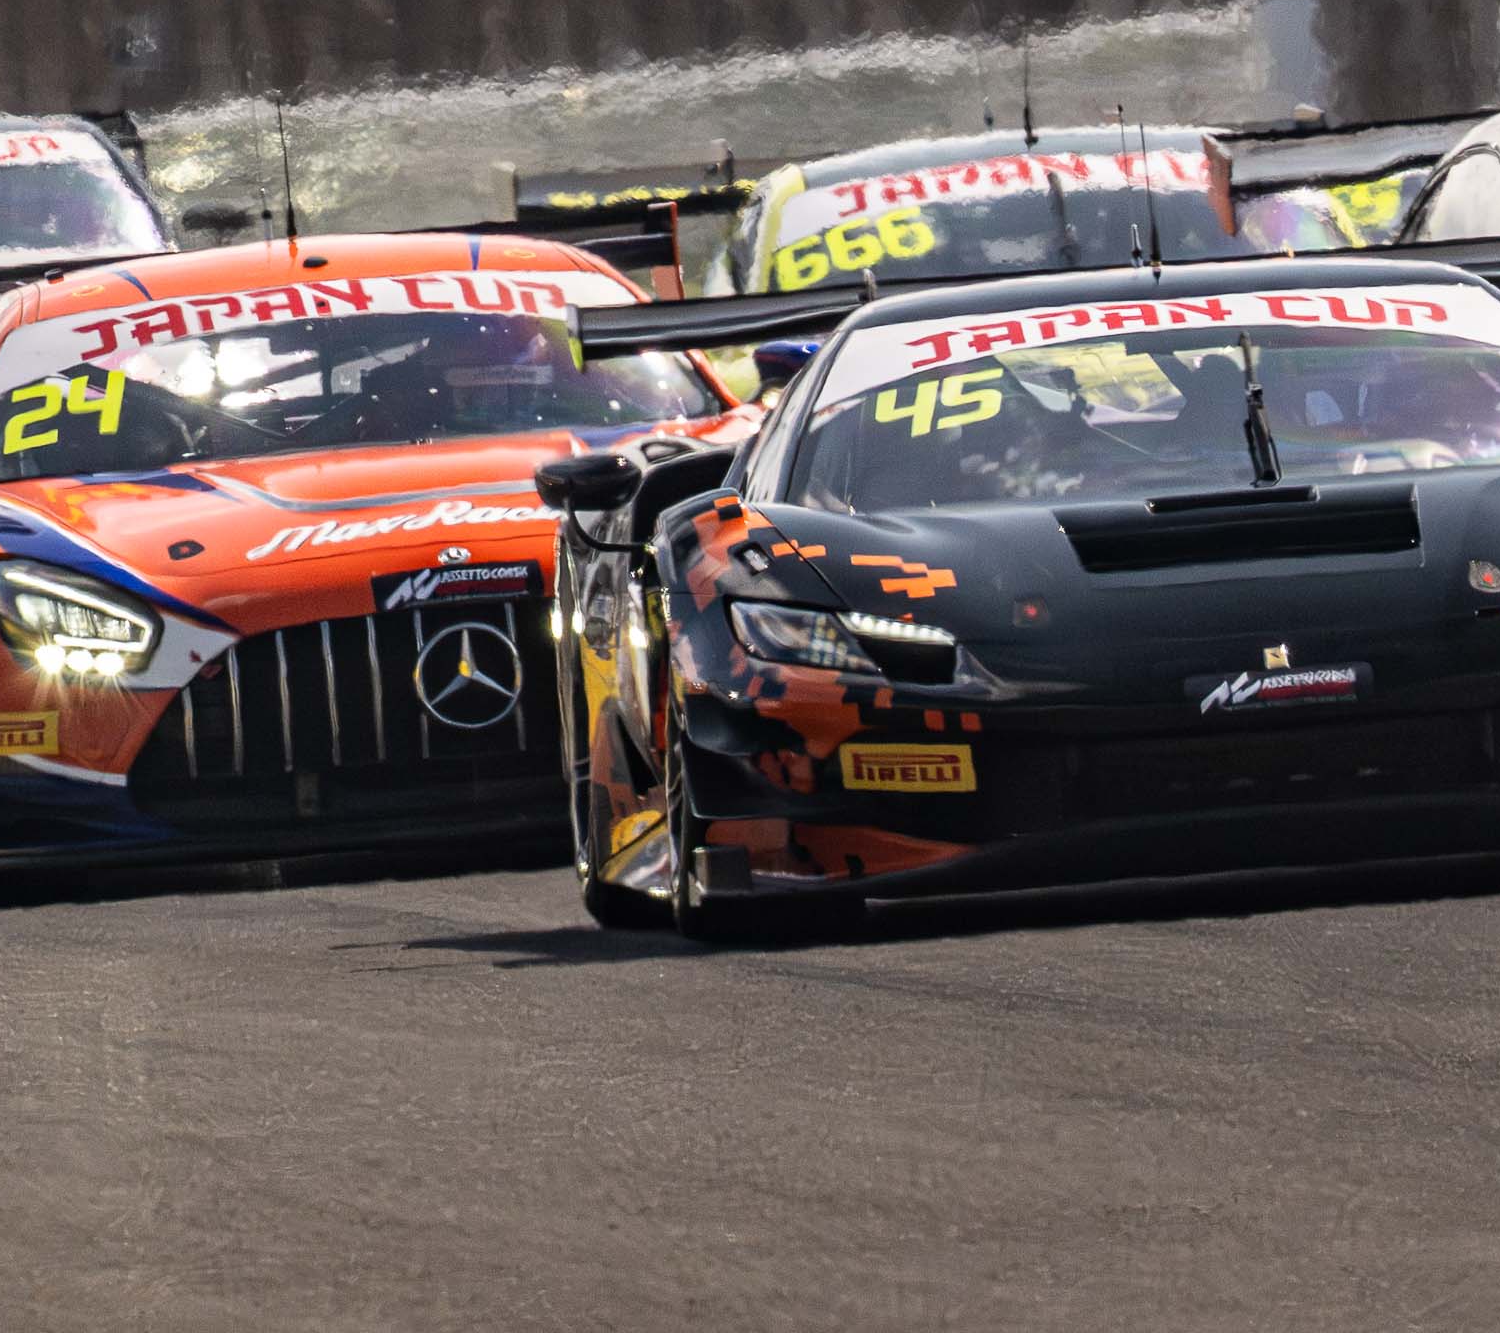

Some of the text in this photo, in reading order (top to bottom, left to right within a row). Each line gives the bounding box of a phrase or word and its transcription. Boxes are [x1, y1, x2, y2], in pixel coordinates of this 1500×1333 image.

[832, 151, 1090, 219] JAPAN
[774, 204, 936, 293] 666
[74, 276, 566, 361] JAPAN CUP
[906, 295, 1448, 369] JAPAN CUP
[3, 370, 126, 455] 24
[876, 368, 1003, 438] 45
[852, 752, 962, 782] PIRELLI
